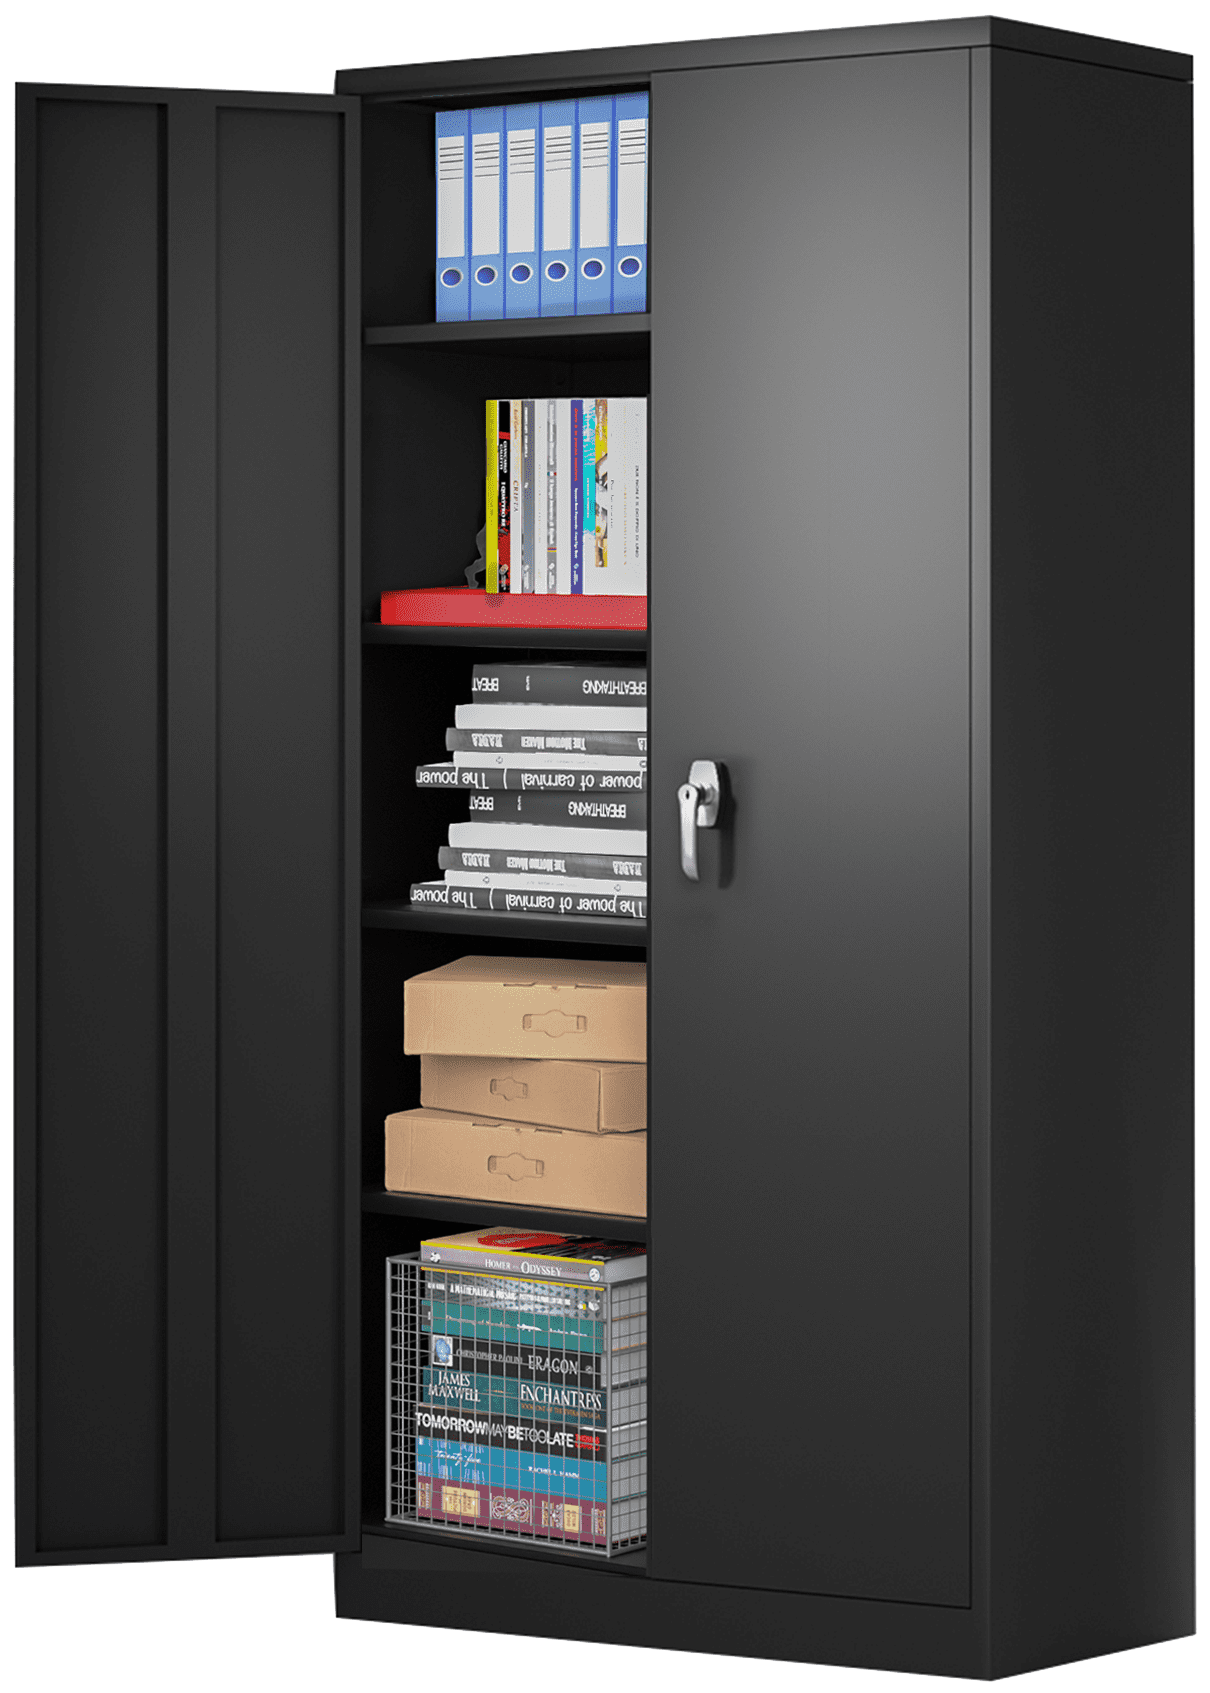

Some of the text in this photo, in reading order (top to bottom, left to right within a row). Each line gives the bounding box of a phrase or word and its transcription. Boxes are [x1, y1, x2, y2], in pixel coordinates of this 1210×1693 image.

[582, 680, 647, 695] BREATHTAKING
[416, 766, 489, 789] The power
[521, 770, 643, 791] power of carnival
[568, 801, 627, 818] BREATHTAKING
[410, 885, 477, 909] The power
[505, 893, 647, 918] The power of carnival
[485, 1259, 511, 1269] HOMER
[521, 1261, 562, 1276] ODYSSEY
[528, 1355, 578, 1375] ERAGON
[438, 1370, 470, 1387] JAMES
[428, 1384, 481, 1402] MAXWELL
[521, 1384, 602, 1411] ENCHANTRESS
